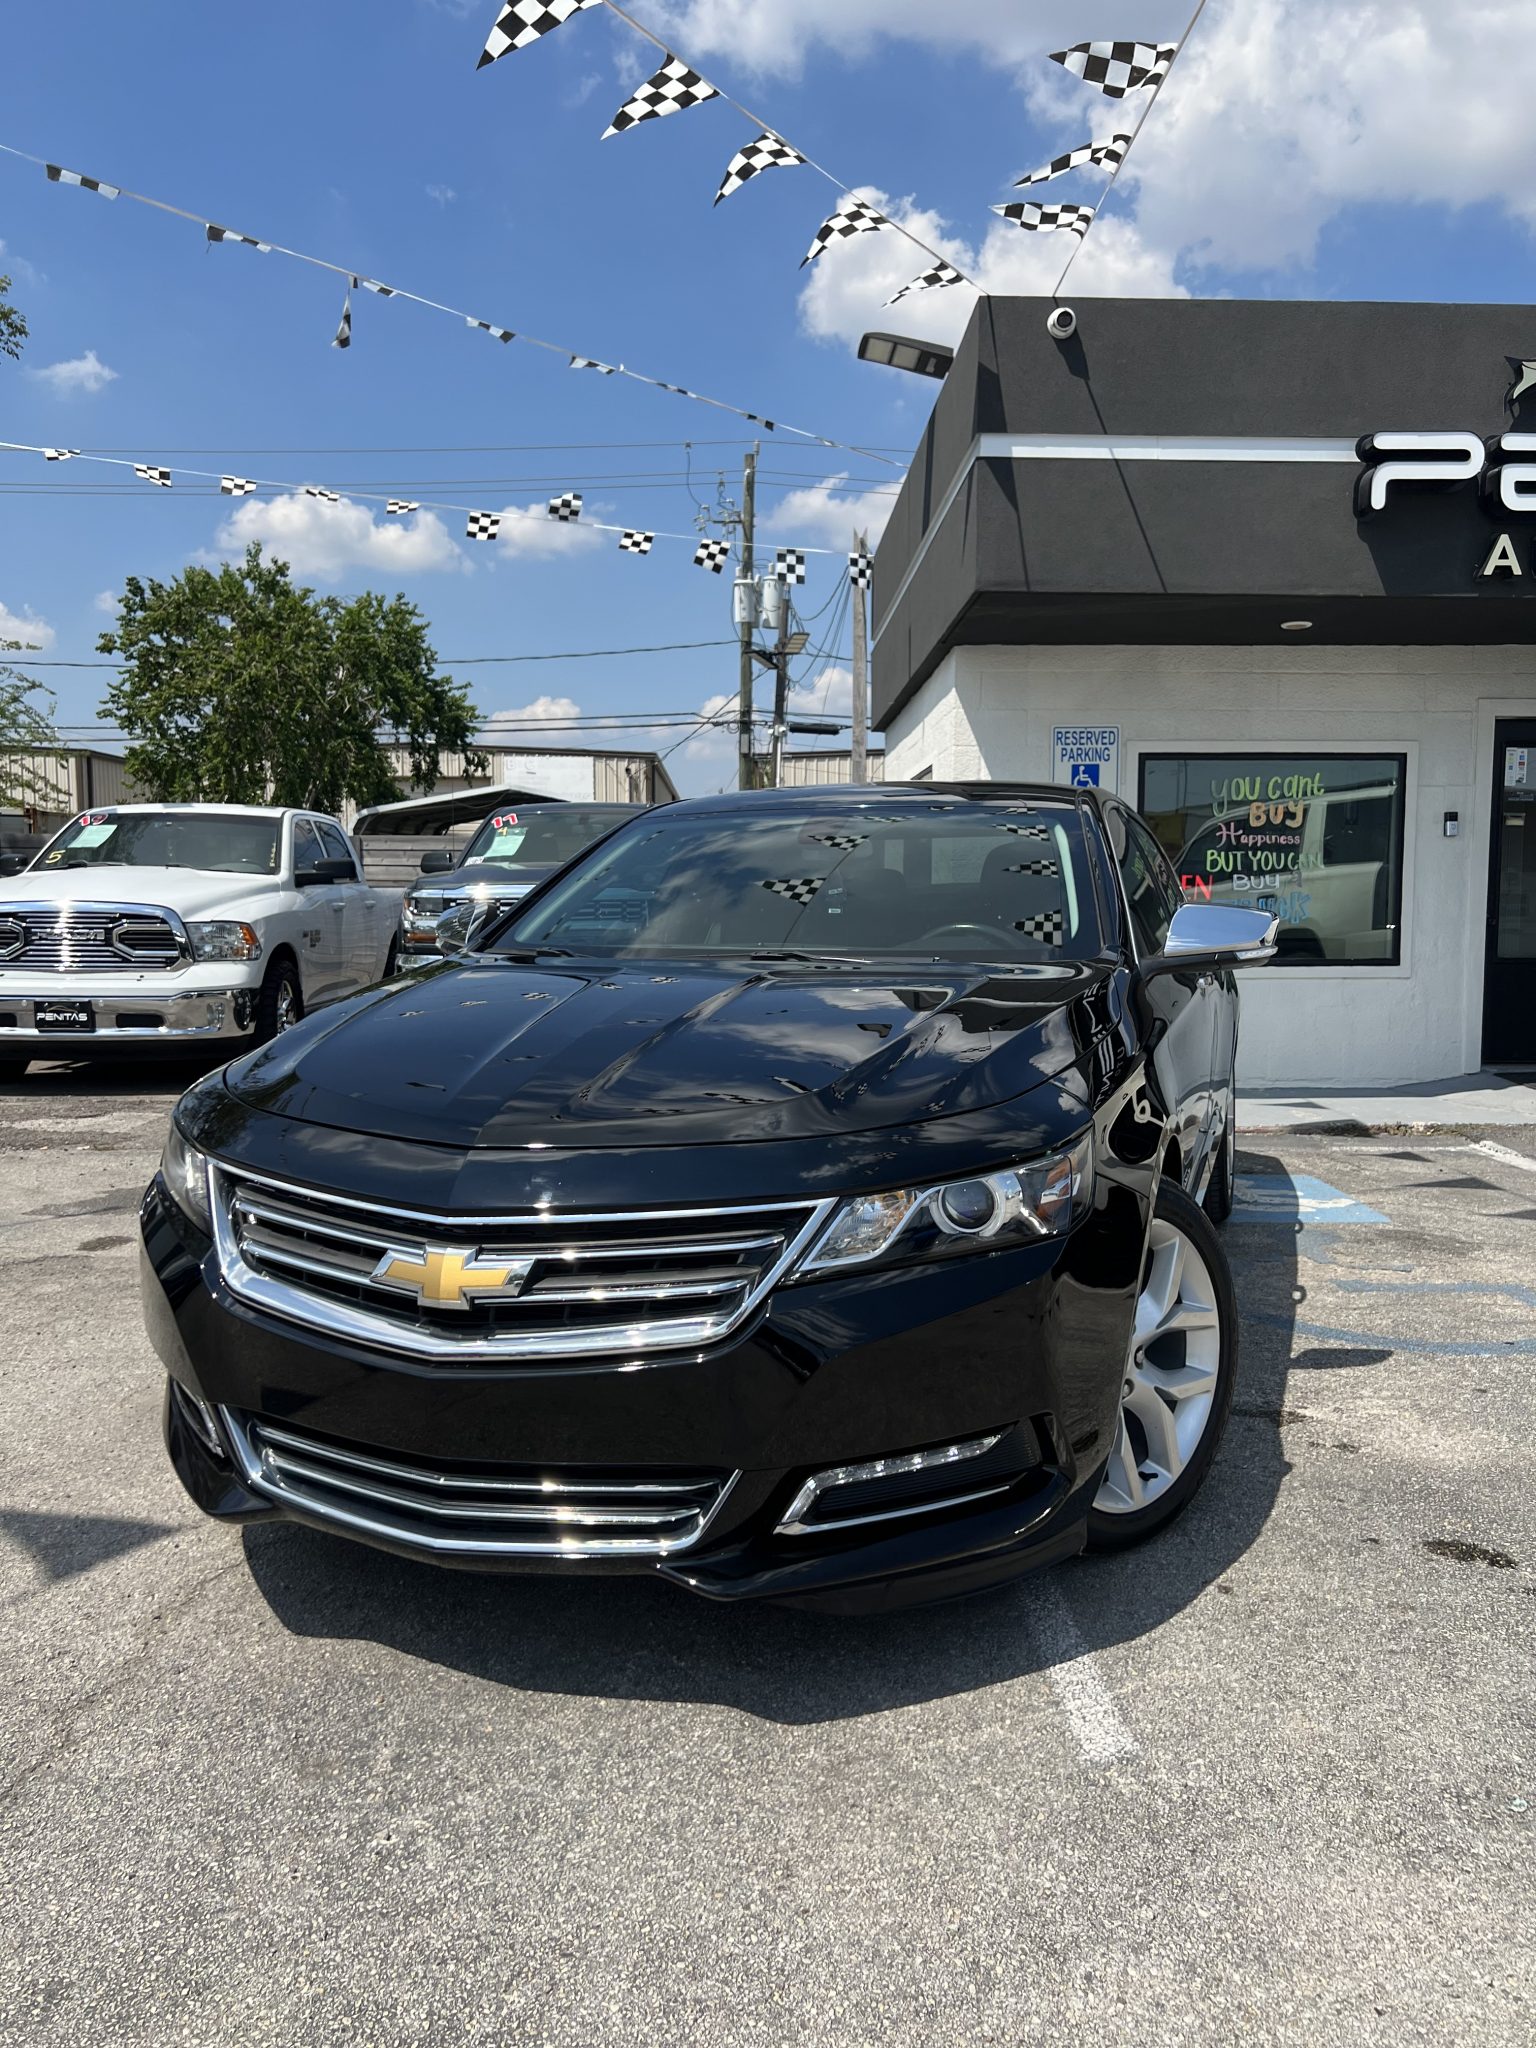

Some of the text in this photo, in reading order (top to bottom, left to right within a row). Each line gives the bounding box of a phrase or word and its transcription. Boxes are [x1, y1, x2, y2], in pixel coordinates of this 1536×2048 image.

[1056, 730, 1116, 746] RESERVED
[1060, 747, 1111, 762] PARKING
[491, 813, 518, 829] 17
[1215, 822, 1301, 848] Happiness
[45, 849, 67, 864] 5
[1206, 849, 1245, 872] BUT
[1248, 850, 1285, 872] YOU
[36, 1012, 88, 1021] PENITAS
